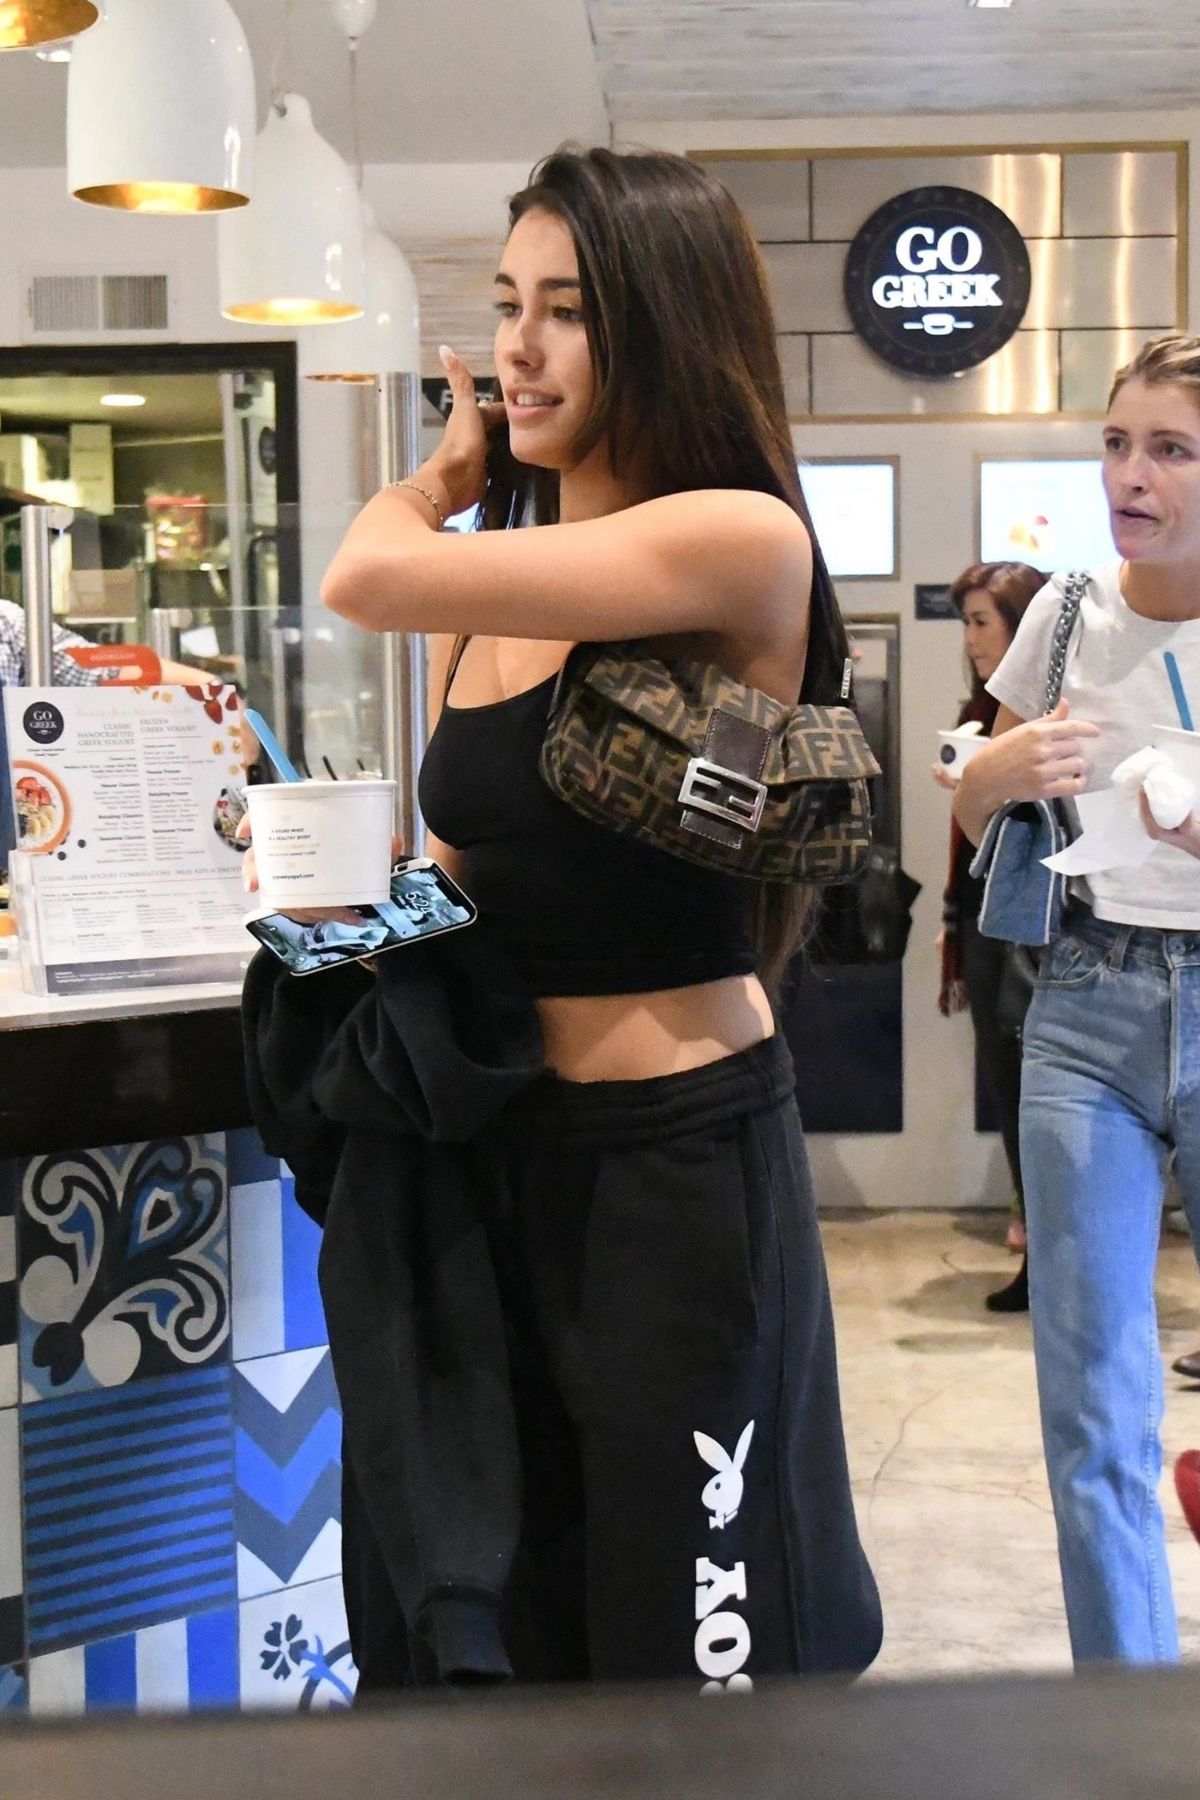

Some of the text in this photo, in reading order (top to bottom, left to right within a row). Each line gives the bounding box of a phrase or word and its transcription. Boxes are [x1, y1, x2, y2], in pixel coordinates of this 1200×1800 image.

[895, 225, 983, 273] GO
[871, 273, 1004, 309] GREEK
[29, 721, 58, 729] GREEK
[33, 710, 53, 721] GO
